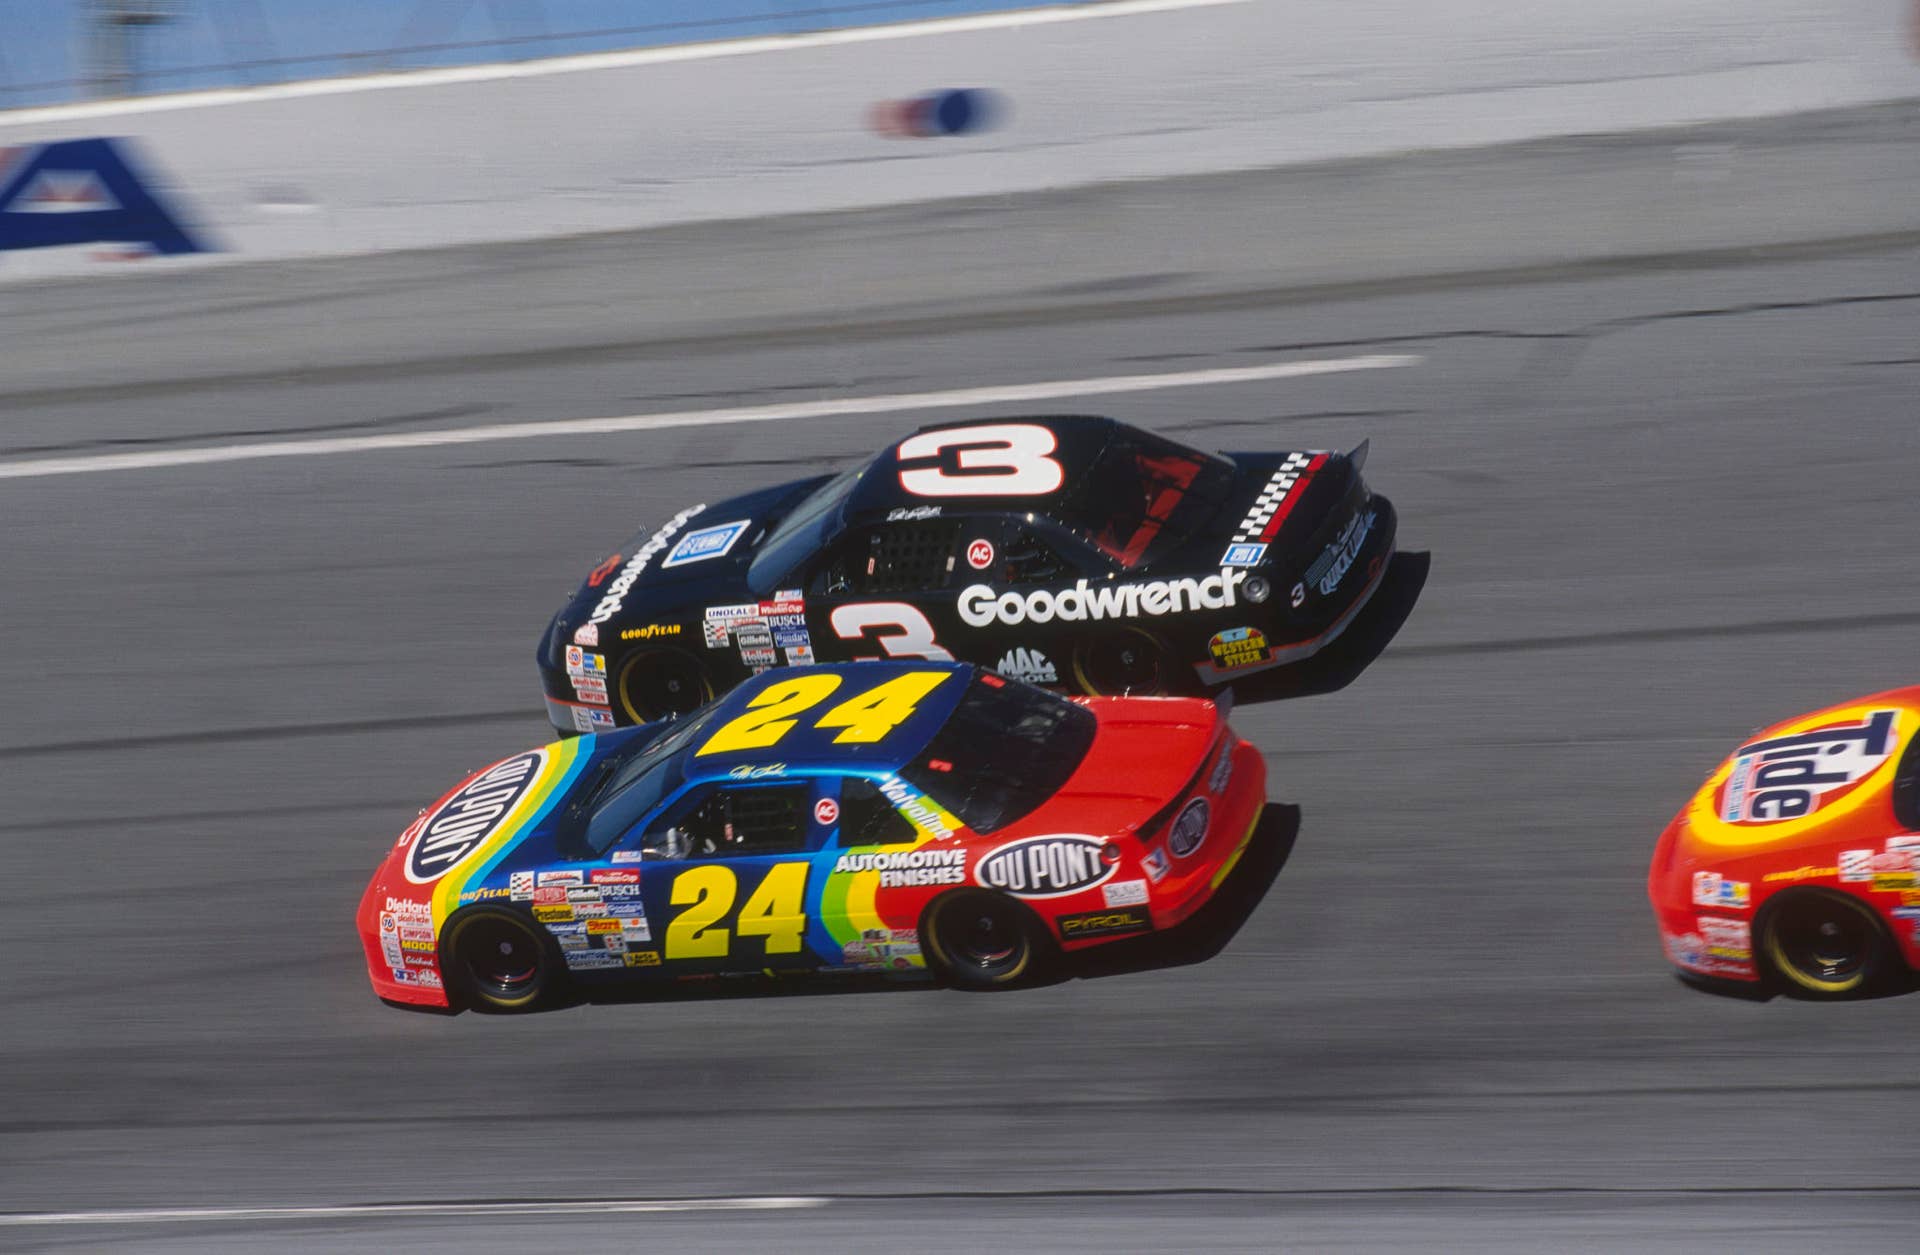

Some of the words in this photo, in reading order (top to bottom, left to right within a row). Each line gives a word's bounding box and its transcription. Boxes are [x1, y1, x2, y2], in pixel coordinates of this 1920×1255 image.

[896, 423, 1065, 497] 3
[970, 547, 991, 560] AC
[957, 566, 1248, 627] Goodwrench
[1290, 581, 1306, 609] 3
[708, 607, 748, 618] UNOCAL
[770, 614, 806, 627] BUSCH
[620, 624, 681, 640] GOODYEAR
[997, 648, 1056, 676] MAC
[695, 671, 952, 757] 24
[1736, 711, 1895, 820] Tide
[878, 776, 955, 842] Valvoline
[833, 849, 968, 874] AUTOMOTIVE
[987, 849, 1027, 891] DU
[1027, 842, 1102, 890] PONT
[880, 866, 967, 888] FINISHES
[601, 884, 640, 897] BUSCH
[386, 897, 432, 915] DieHard
[665, 861, 811, 960] 24
[1062, 913, 1145, 931] PYROIL
[401, 940, 435, 952] MOOG
